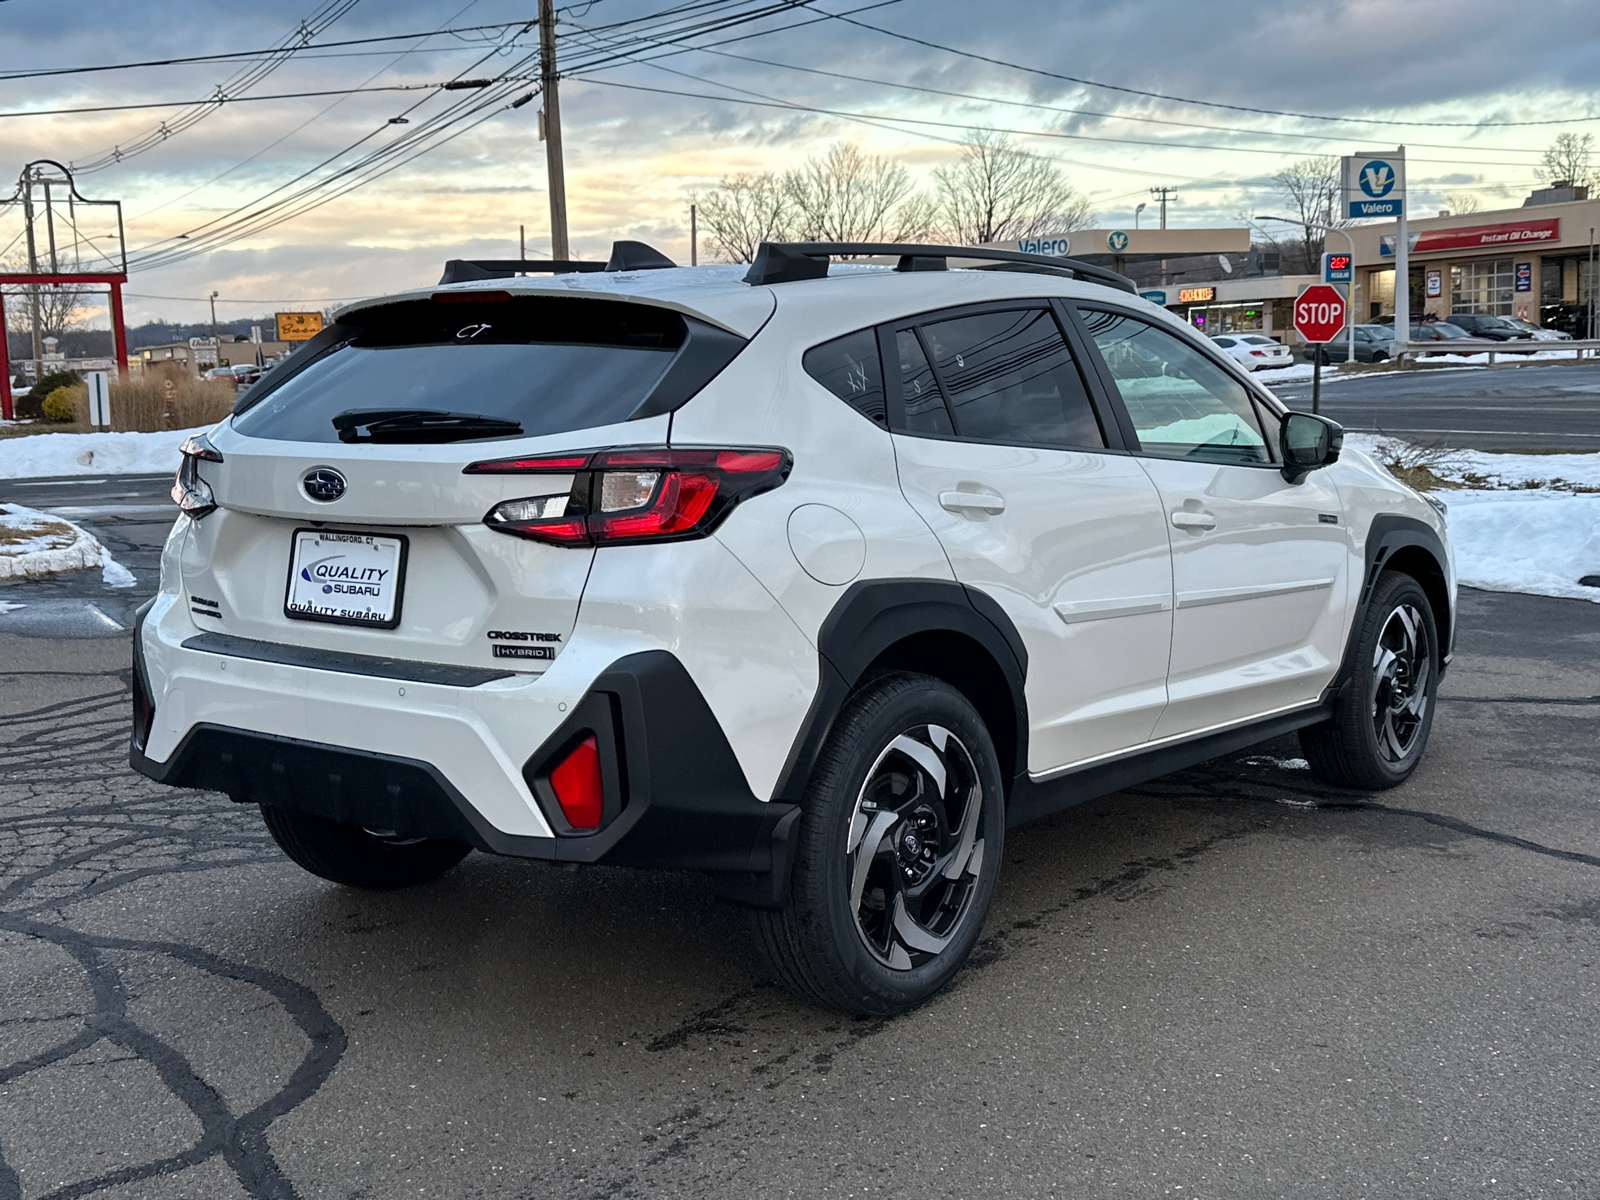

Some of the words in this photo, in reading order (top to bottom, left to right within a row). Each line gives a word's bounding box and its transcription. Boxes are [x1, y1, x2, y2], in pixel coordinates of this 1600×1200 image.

[1361, 203, 1393, 214] Valero
[1480, 233, 1509, 243] Instant
[1509, 231, 1521, 240] Oil
[1521, 230, 1553, 240] Change
[1018, 238, 1069, 256] Valero
[1297, 303, 1342, 324] STOP
[365, 537, 374, 545] CT
[316, 564, 389, 581] QUALITY
[333, 584, 381, 597] SUBARU
[290, 603, 337, 616] QUALITY
[340, 609, 386, 621] SUBARU
[487, 630, 562, 643] CROSSTREK
[501, 648, 544, 657] HYBRID
